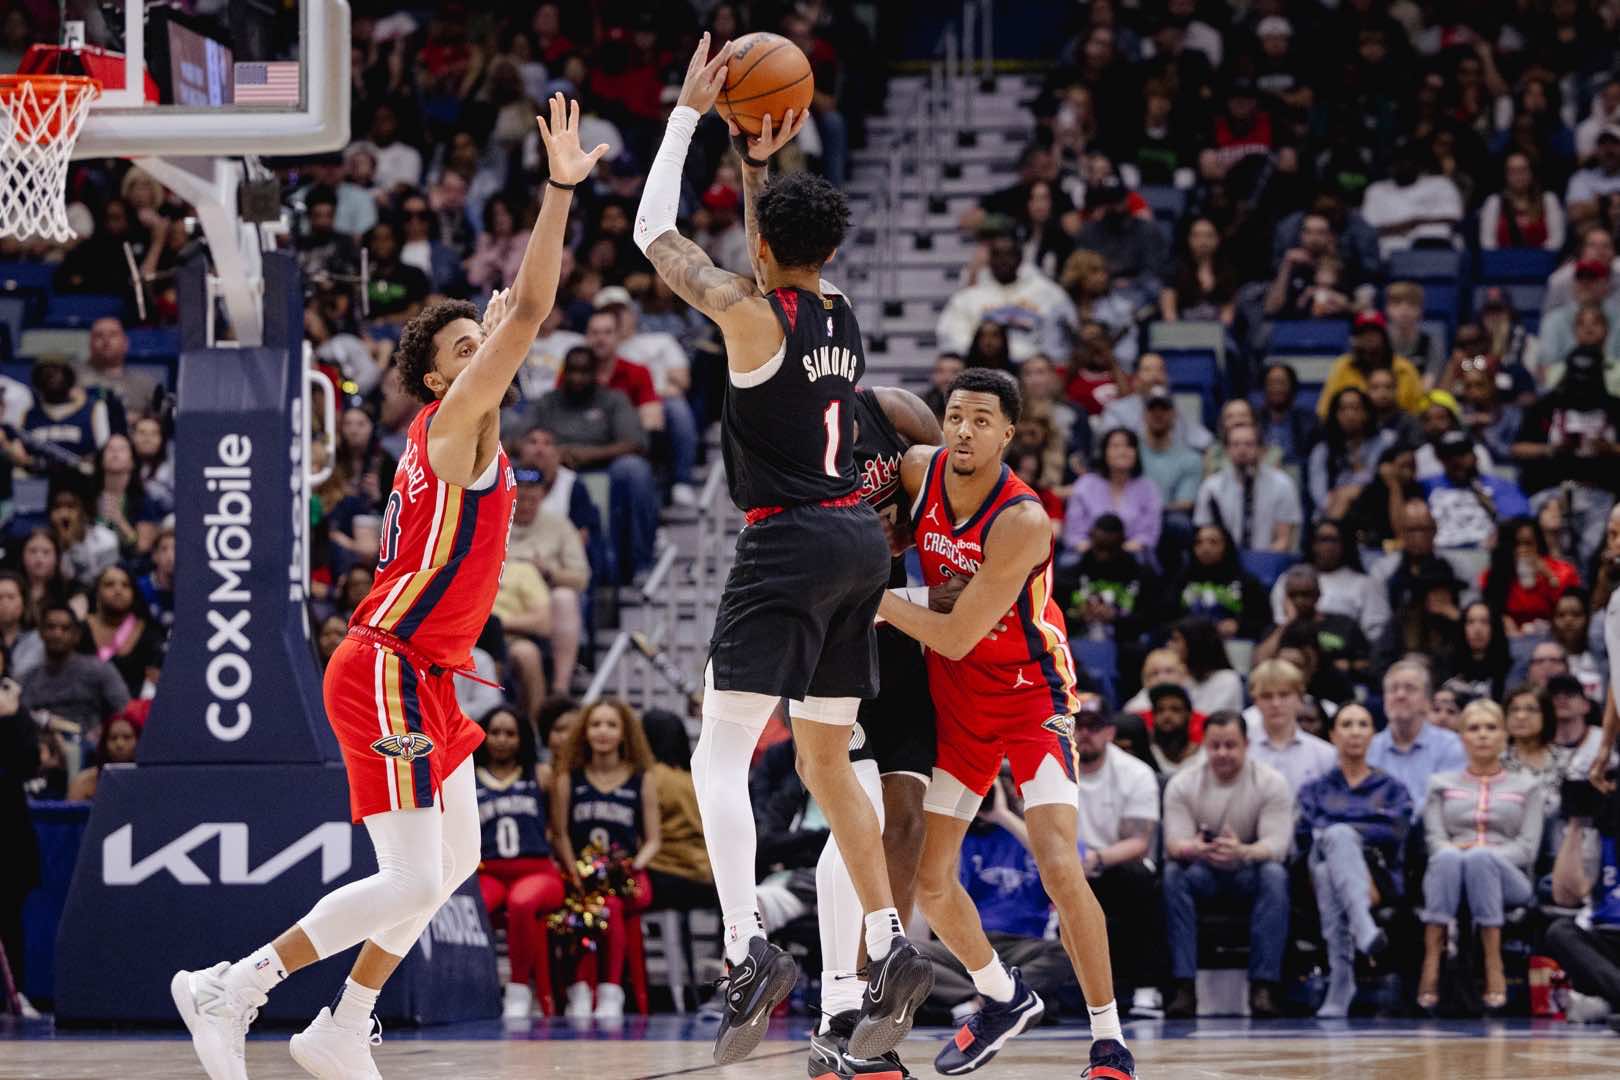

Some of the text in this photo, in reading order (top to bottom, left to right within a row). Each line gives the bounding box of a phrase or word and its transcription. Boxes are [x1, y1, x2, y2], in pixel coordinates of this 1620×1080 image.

[802, 345, 857, 383] SIMONS
[824, 399, 841, 478] 1
[103, 821, 352, 885] KIA
[496, 815, 520, 859] 0
